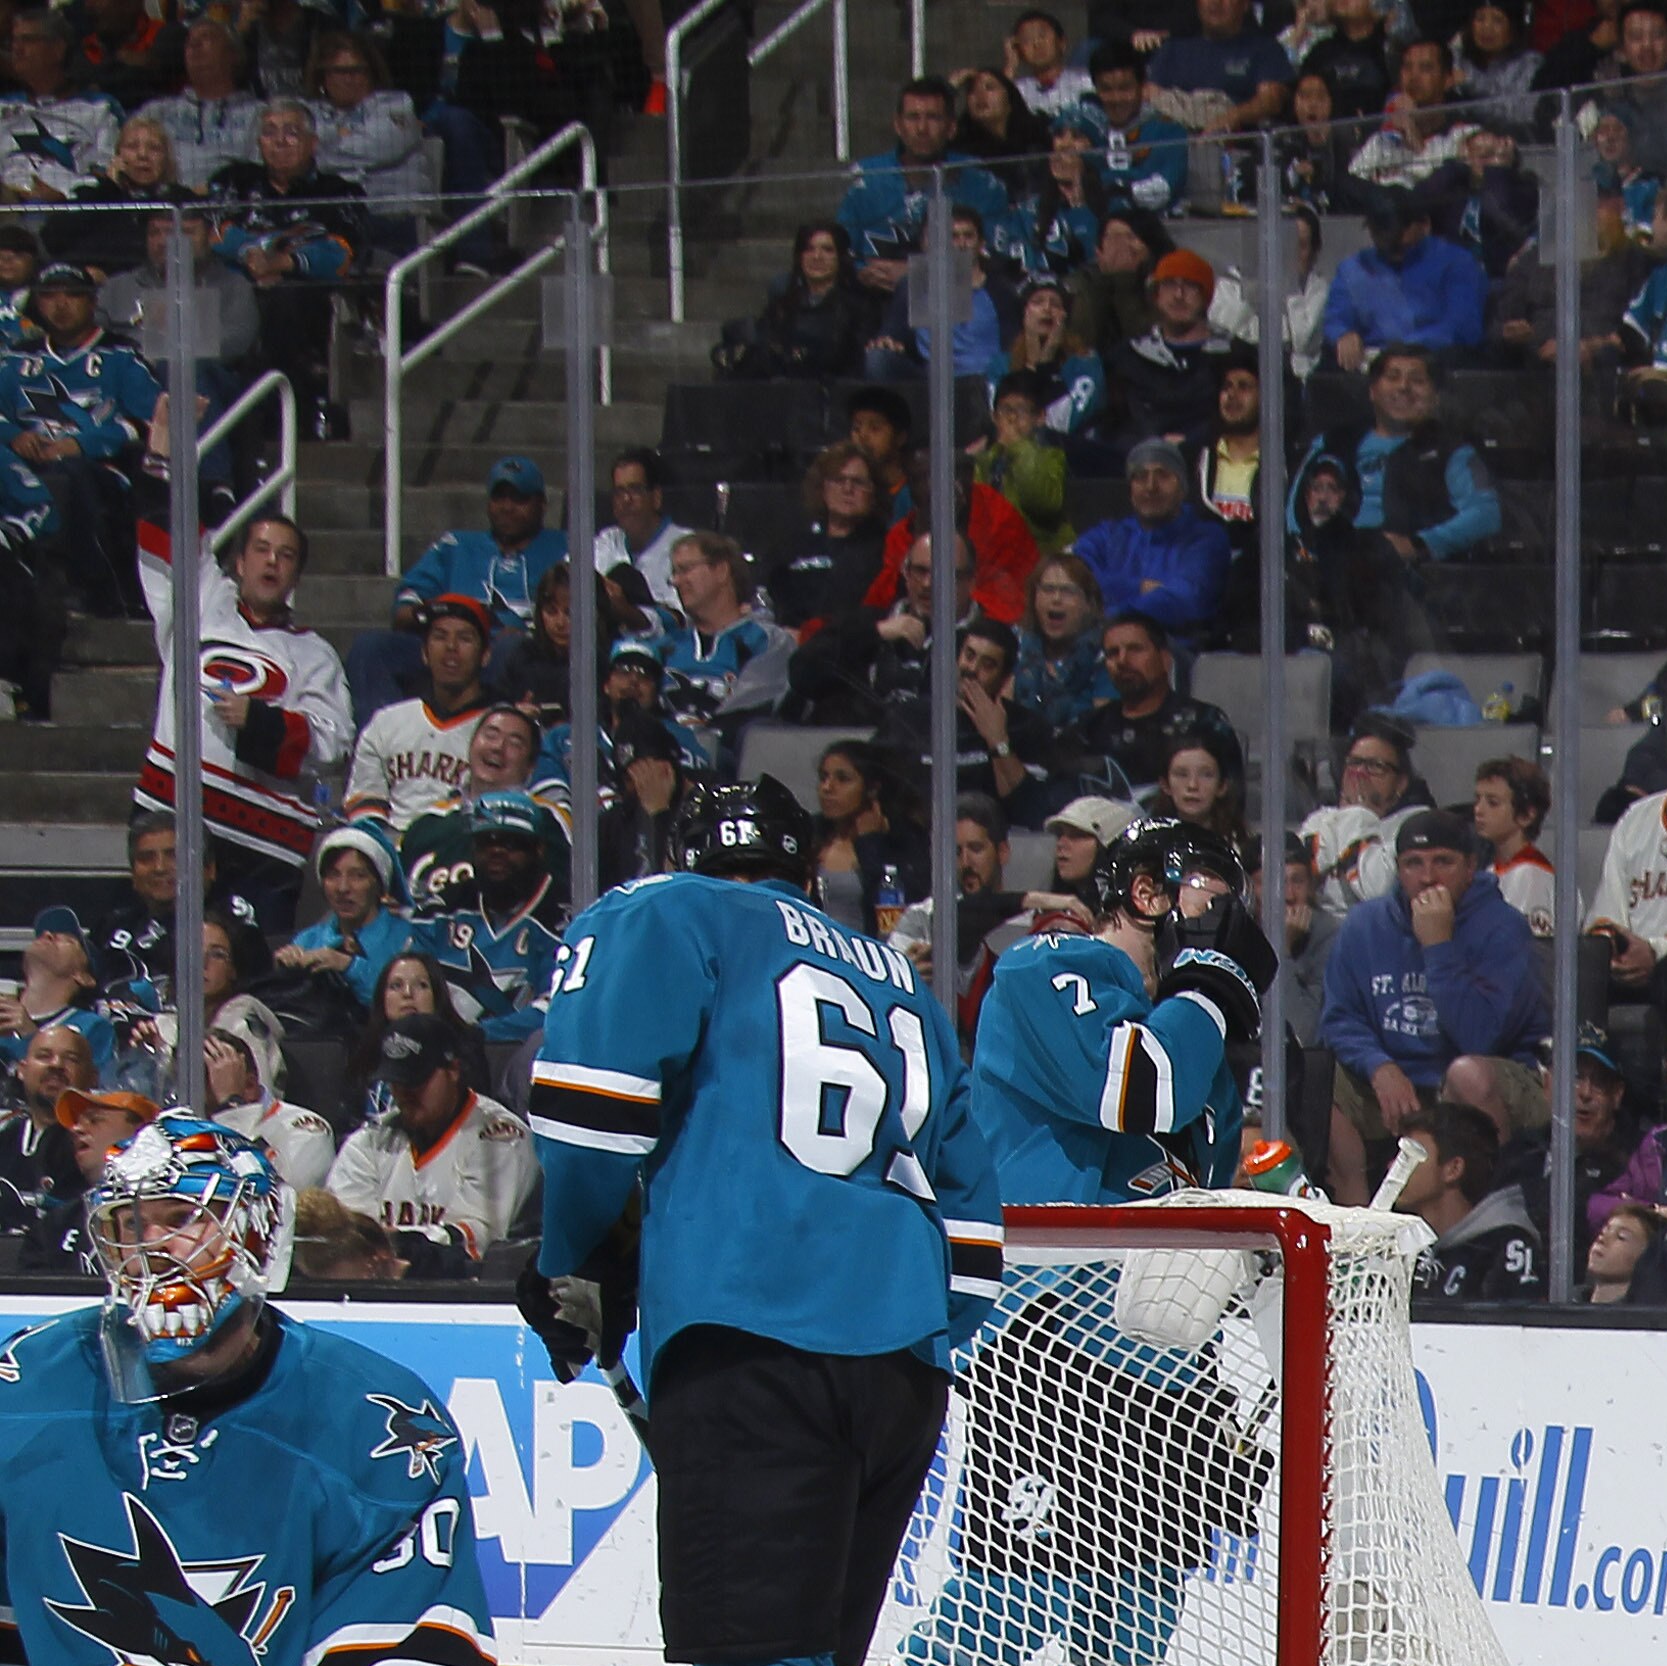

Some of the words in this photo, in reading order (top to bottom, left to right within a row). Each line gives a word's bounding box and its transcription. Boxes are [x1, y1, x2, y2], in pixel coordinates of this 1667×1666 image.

[384, 751, 470, 786] SHARK
[719, 819, 754, 848] 61
[775, 898, 916, 996] BRAUN
[1050, 971, 1098, 1016] 7
[768, 959, 938, 1203] 61
[448, 1377, 642, 1567] AP
